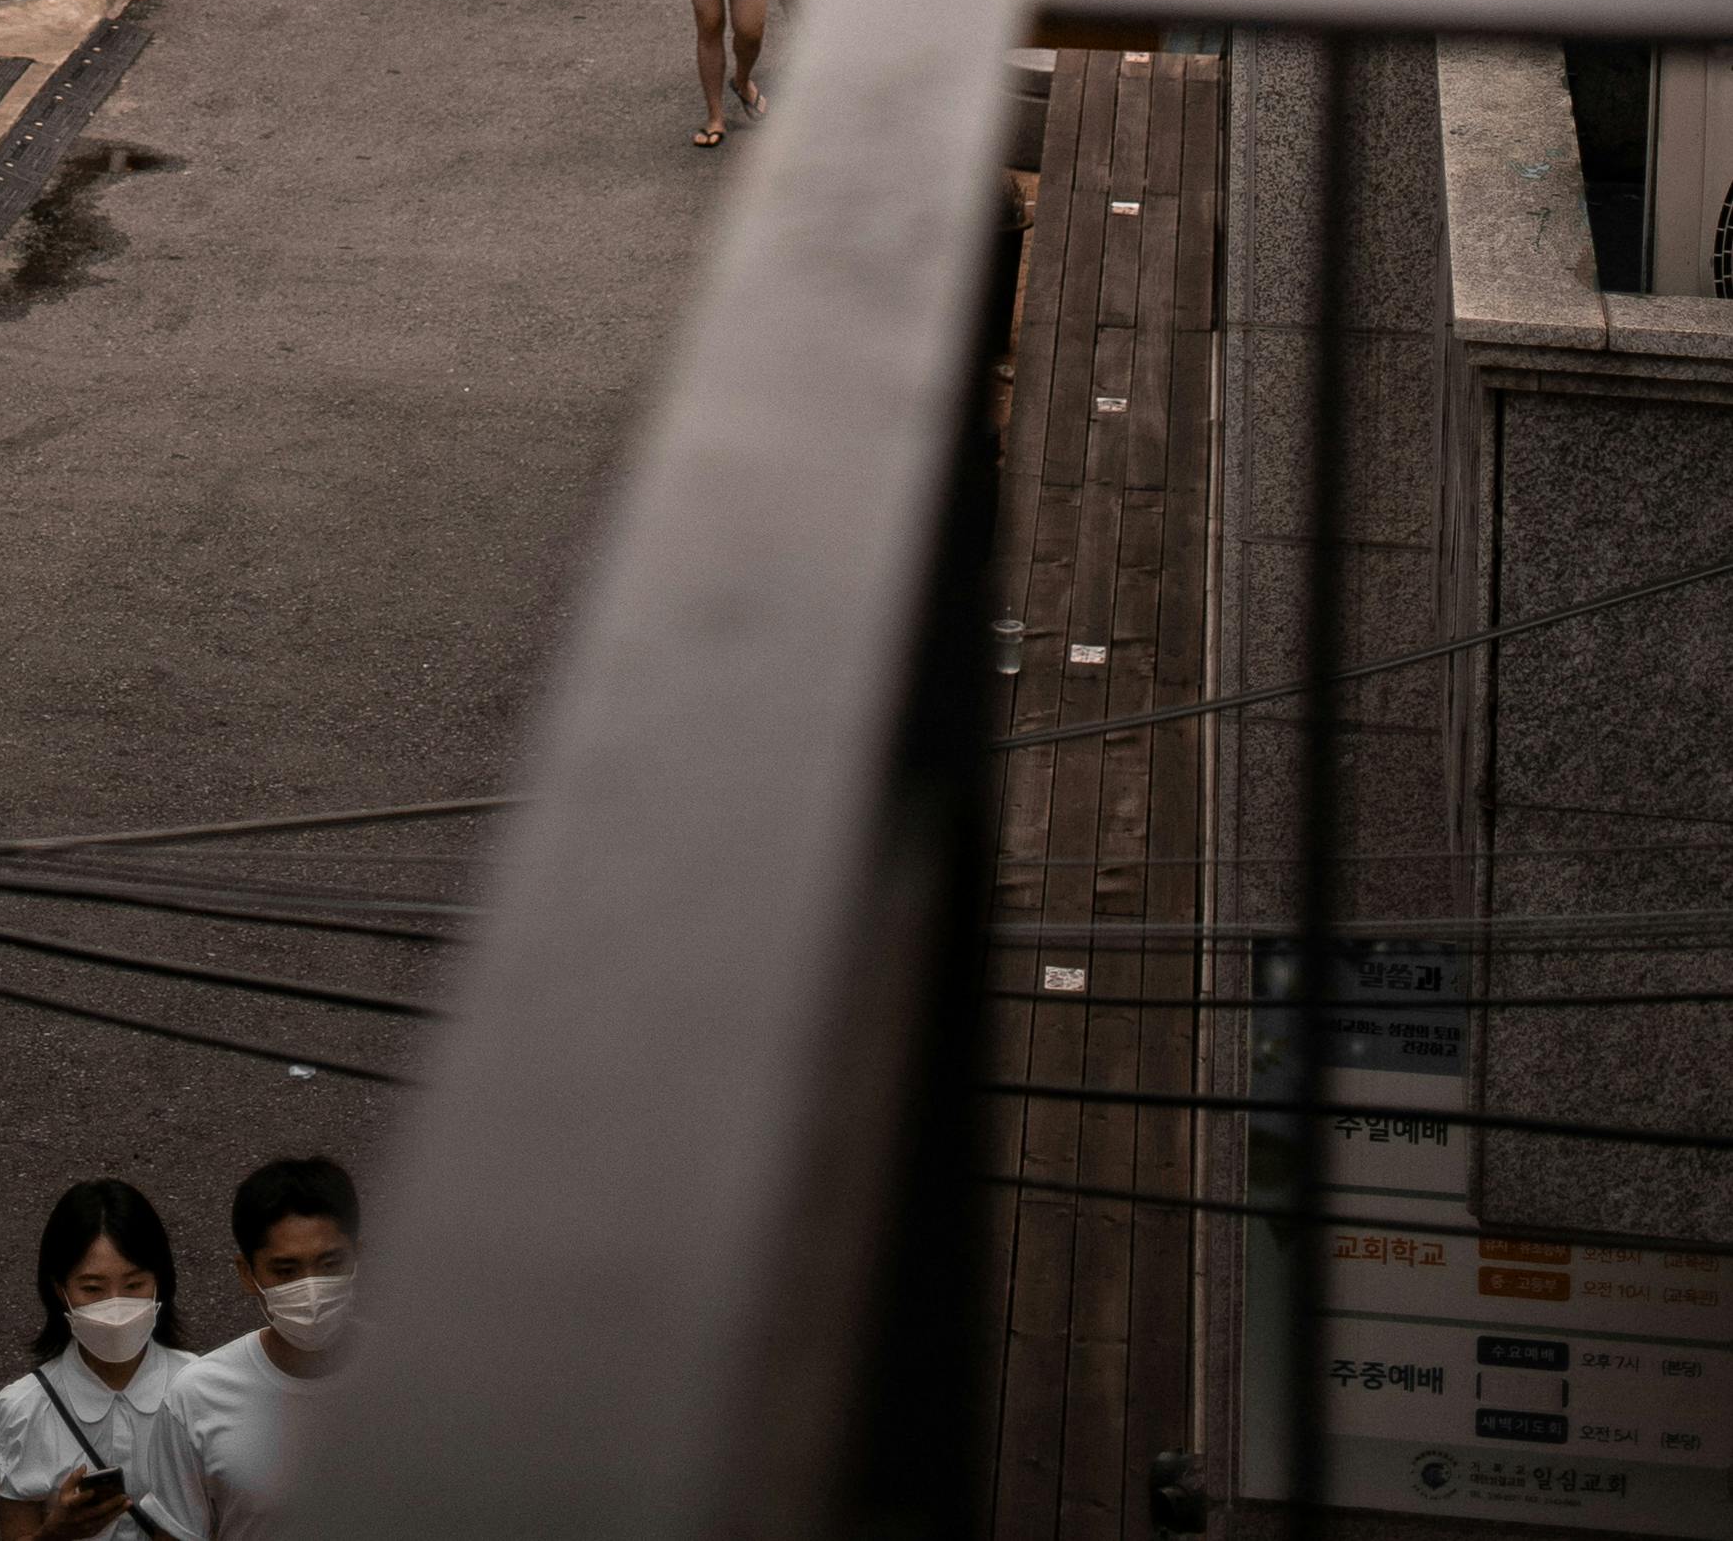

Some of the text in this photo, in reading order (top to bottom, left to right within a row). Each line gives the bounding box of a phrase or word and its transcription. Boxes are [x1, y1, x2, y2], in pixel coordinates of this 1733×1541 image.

[1332, 1234, 1448, 1268] 교회학교
[1580, 1280, 1613, 1297] 오전
[1618, 1282, 1651, 1300] 10시
[1489, 1343, 1556, 1363] 수요예배
[1581, 1353, 1703, 1379] 오후 7시 (본당)
[1329, 1358, 1444, 1396] 주중예배
[1480, 1415, 1564, 1438] 새벽기도회
[1579, 1425, 1702, 1451] 오전 5시 (본당)
[1532, 1467, 1628, 1497] 일심교회
